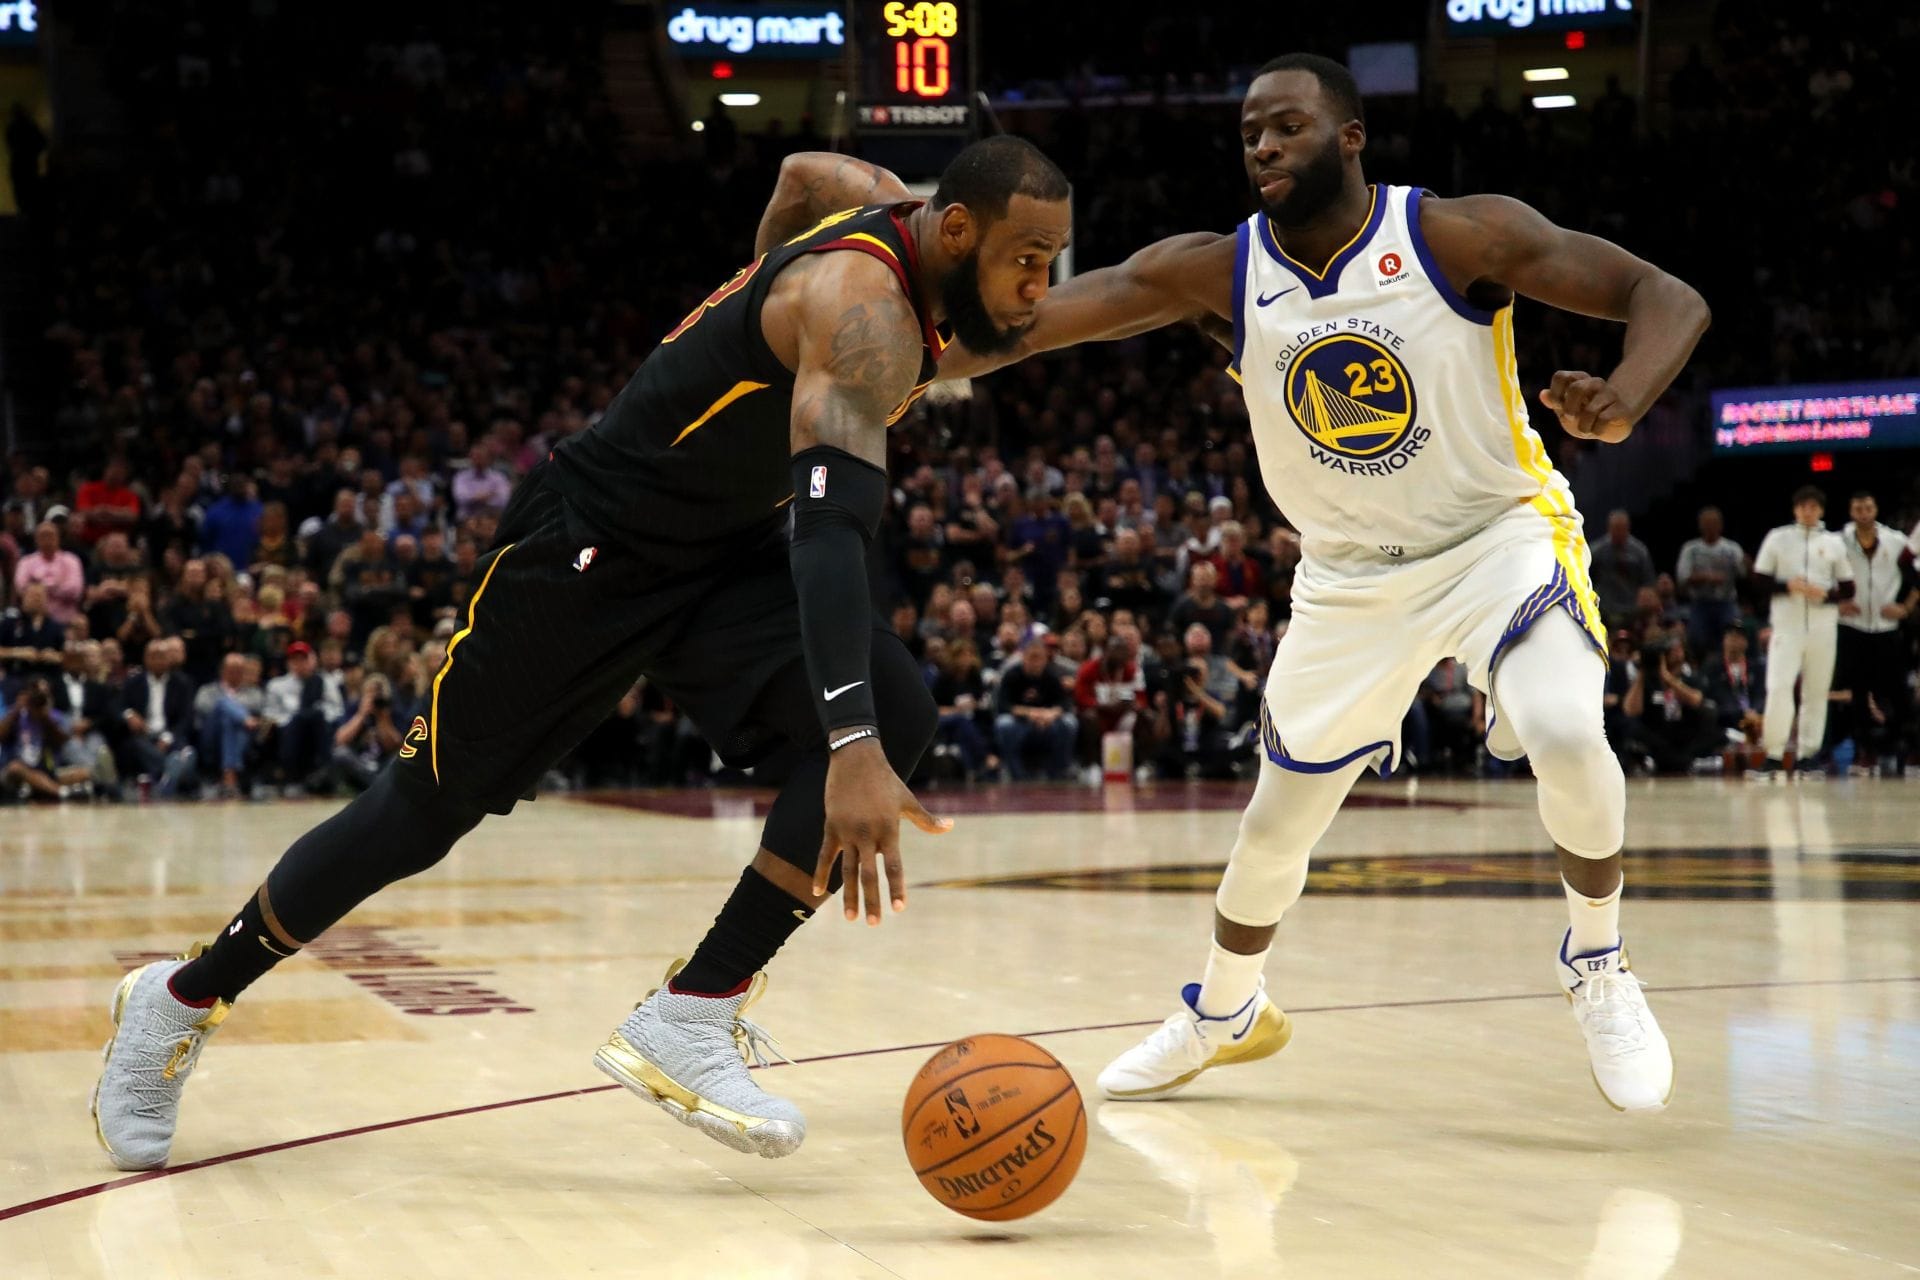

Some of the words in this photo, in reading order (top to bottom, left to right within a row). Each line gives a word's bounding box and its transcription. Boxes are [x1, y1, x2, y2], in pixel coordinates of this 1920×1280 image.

[667, 8, 754, 53] drug
[755, 12, 845, 45] mart
[883, 1, 958, 37] 5:08
[1446, 0, 1535, 28] drug
[896, 37, 950, 97] 10
[888, 105, 968, 125] TISSOT
[1378, 271, 1410, 287] Rakuten
[1275, 320, 1338, 372] GOLDEN
[1347, 318, 1405, 351] STATE
[1343, 358, 1397, 398] 23
[1308, 425, 1432, 477] WARRIORS
[935, 1118, 1057, 1201] SPALDING
